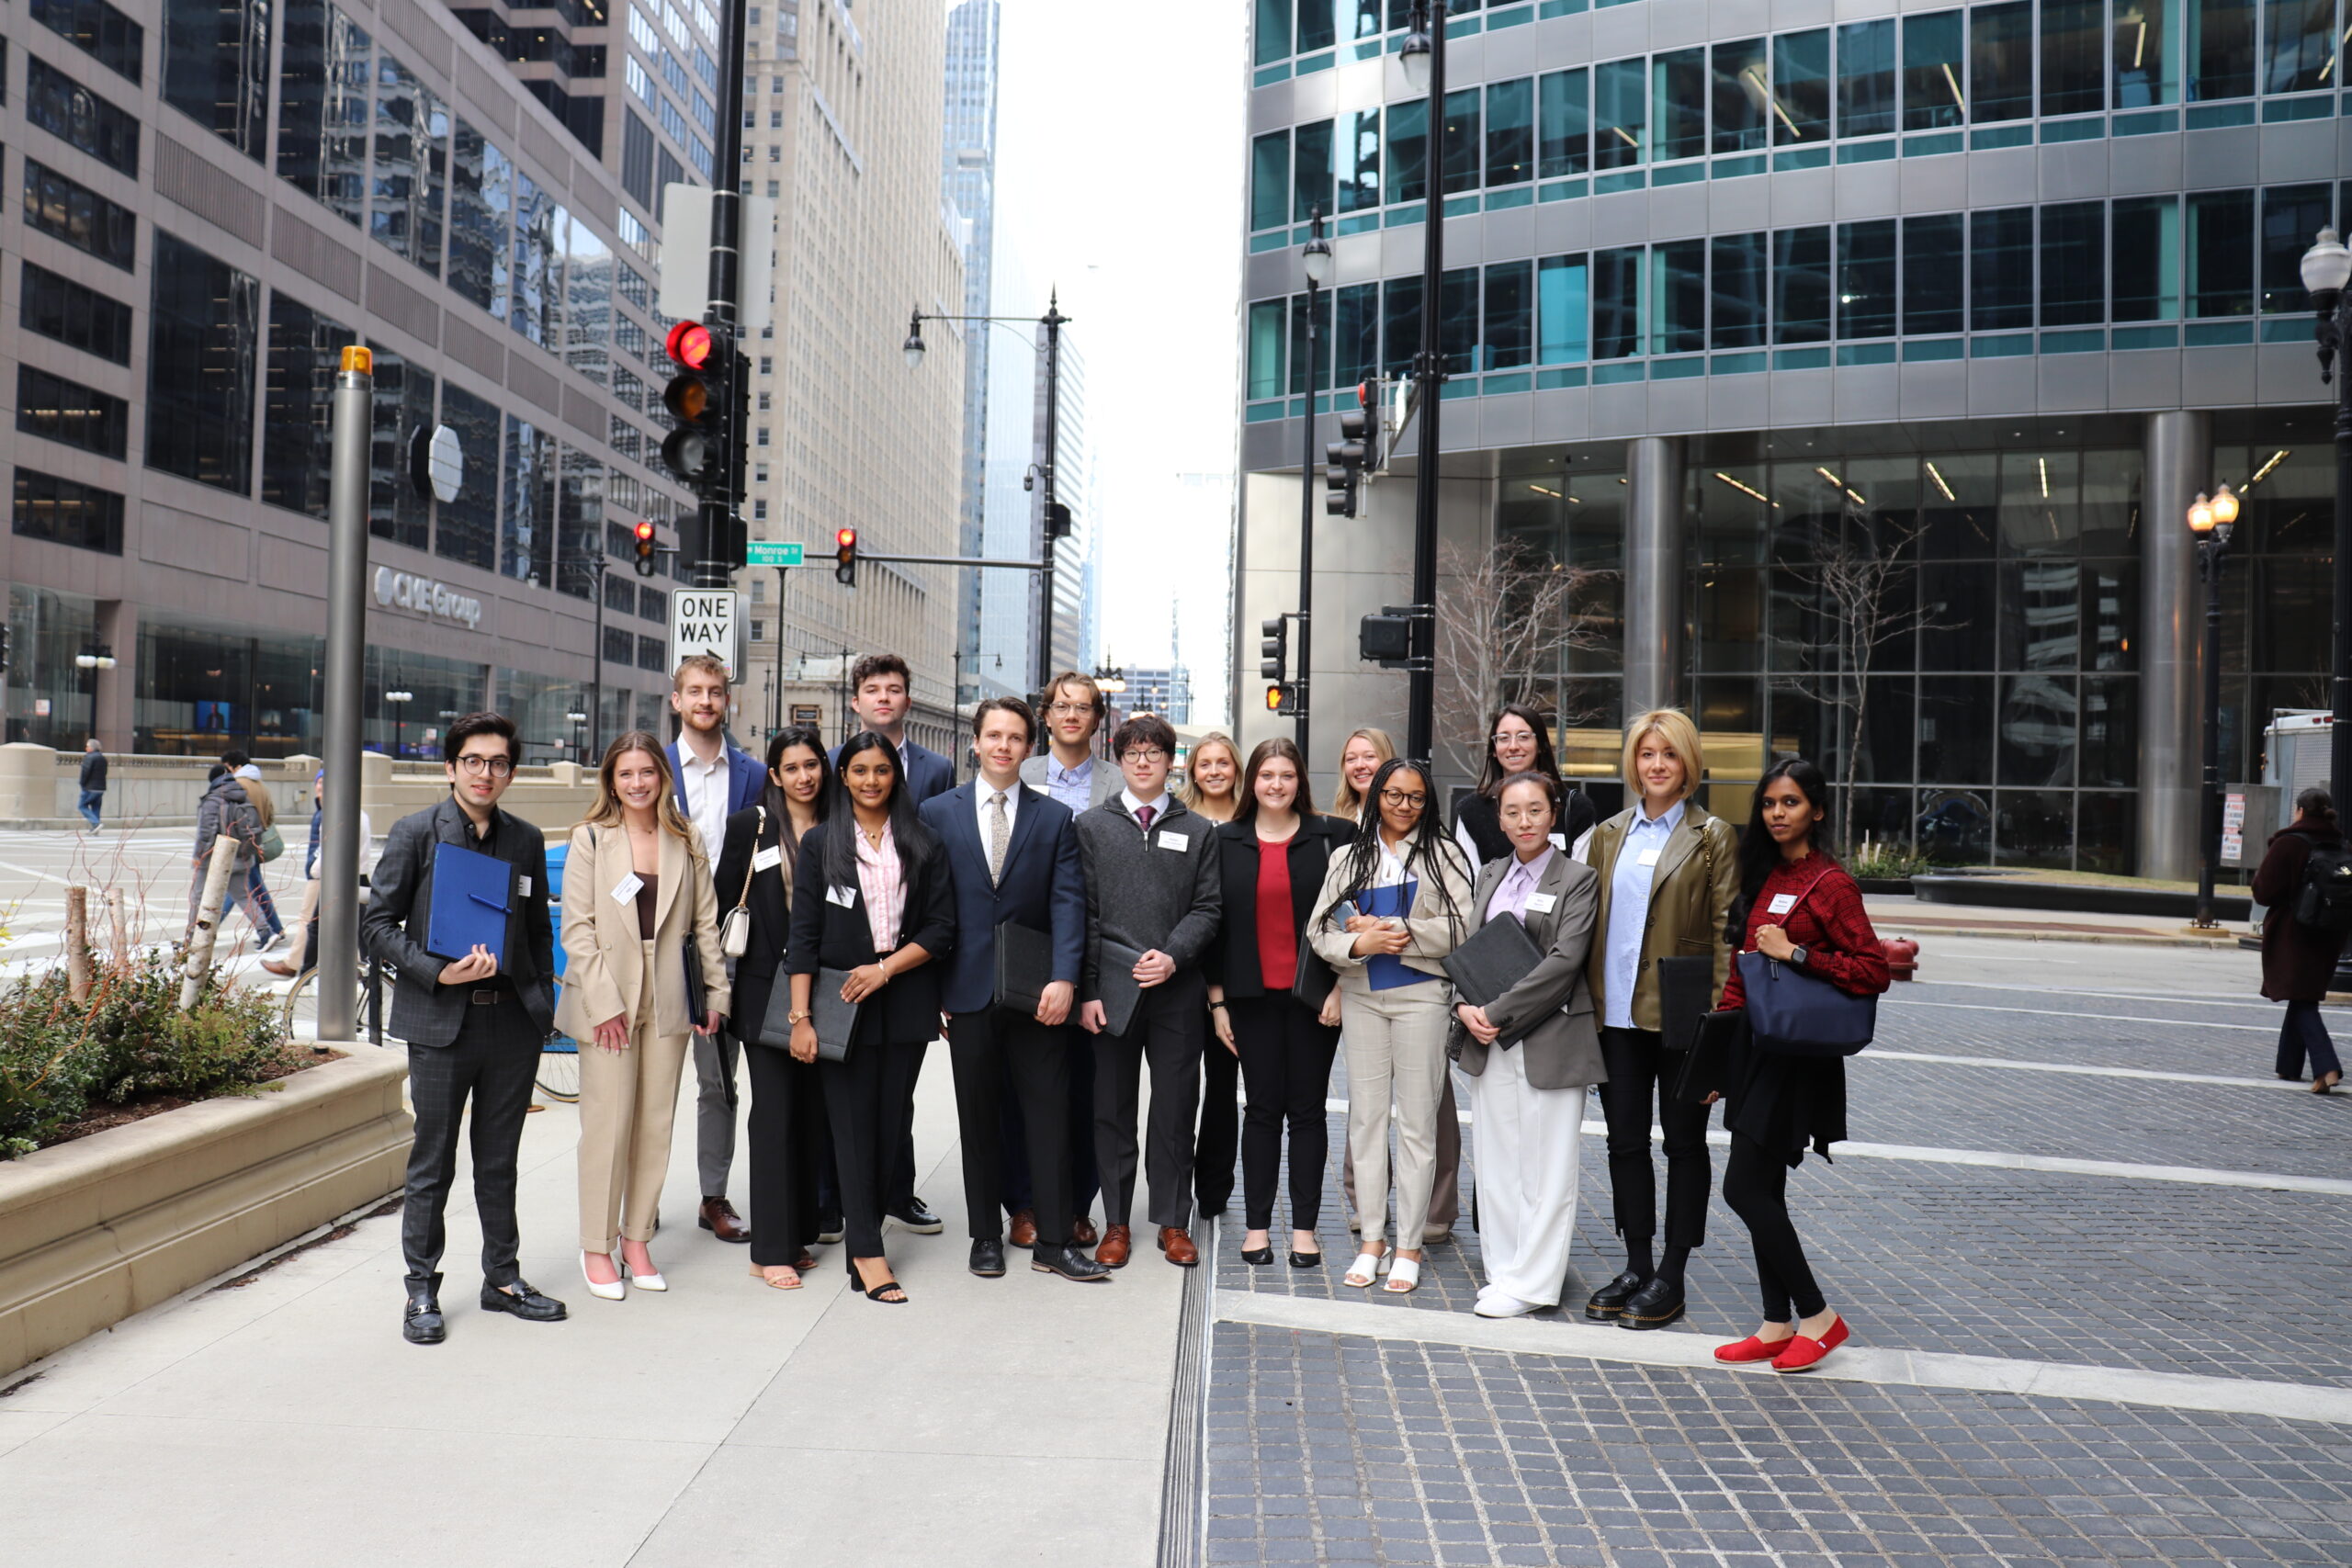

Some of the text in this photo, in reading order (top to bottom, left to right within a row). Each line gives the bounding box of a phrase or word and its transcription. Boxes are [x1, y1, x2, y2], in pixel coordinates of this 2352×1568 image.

[754, 546, 788, 556] Monroe
[683, 598, 729, 617] ONE
[681, 623, 728, 642] WAY
